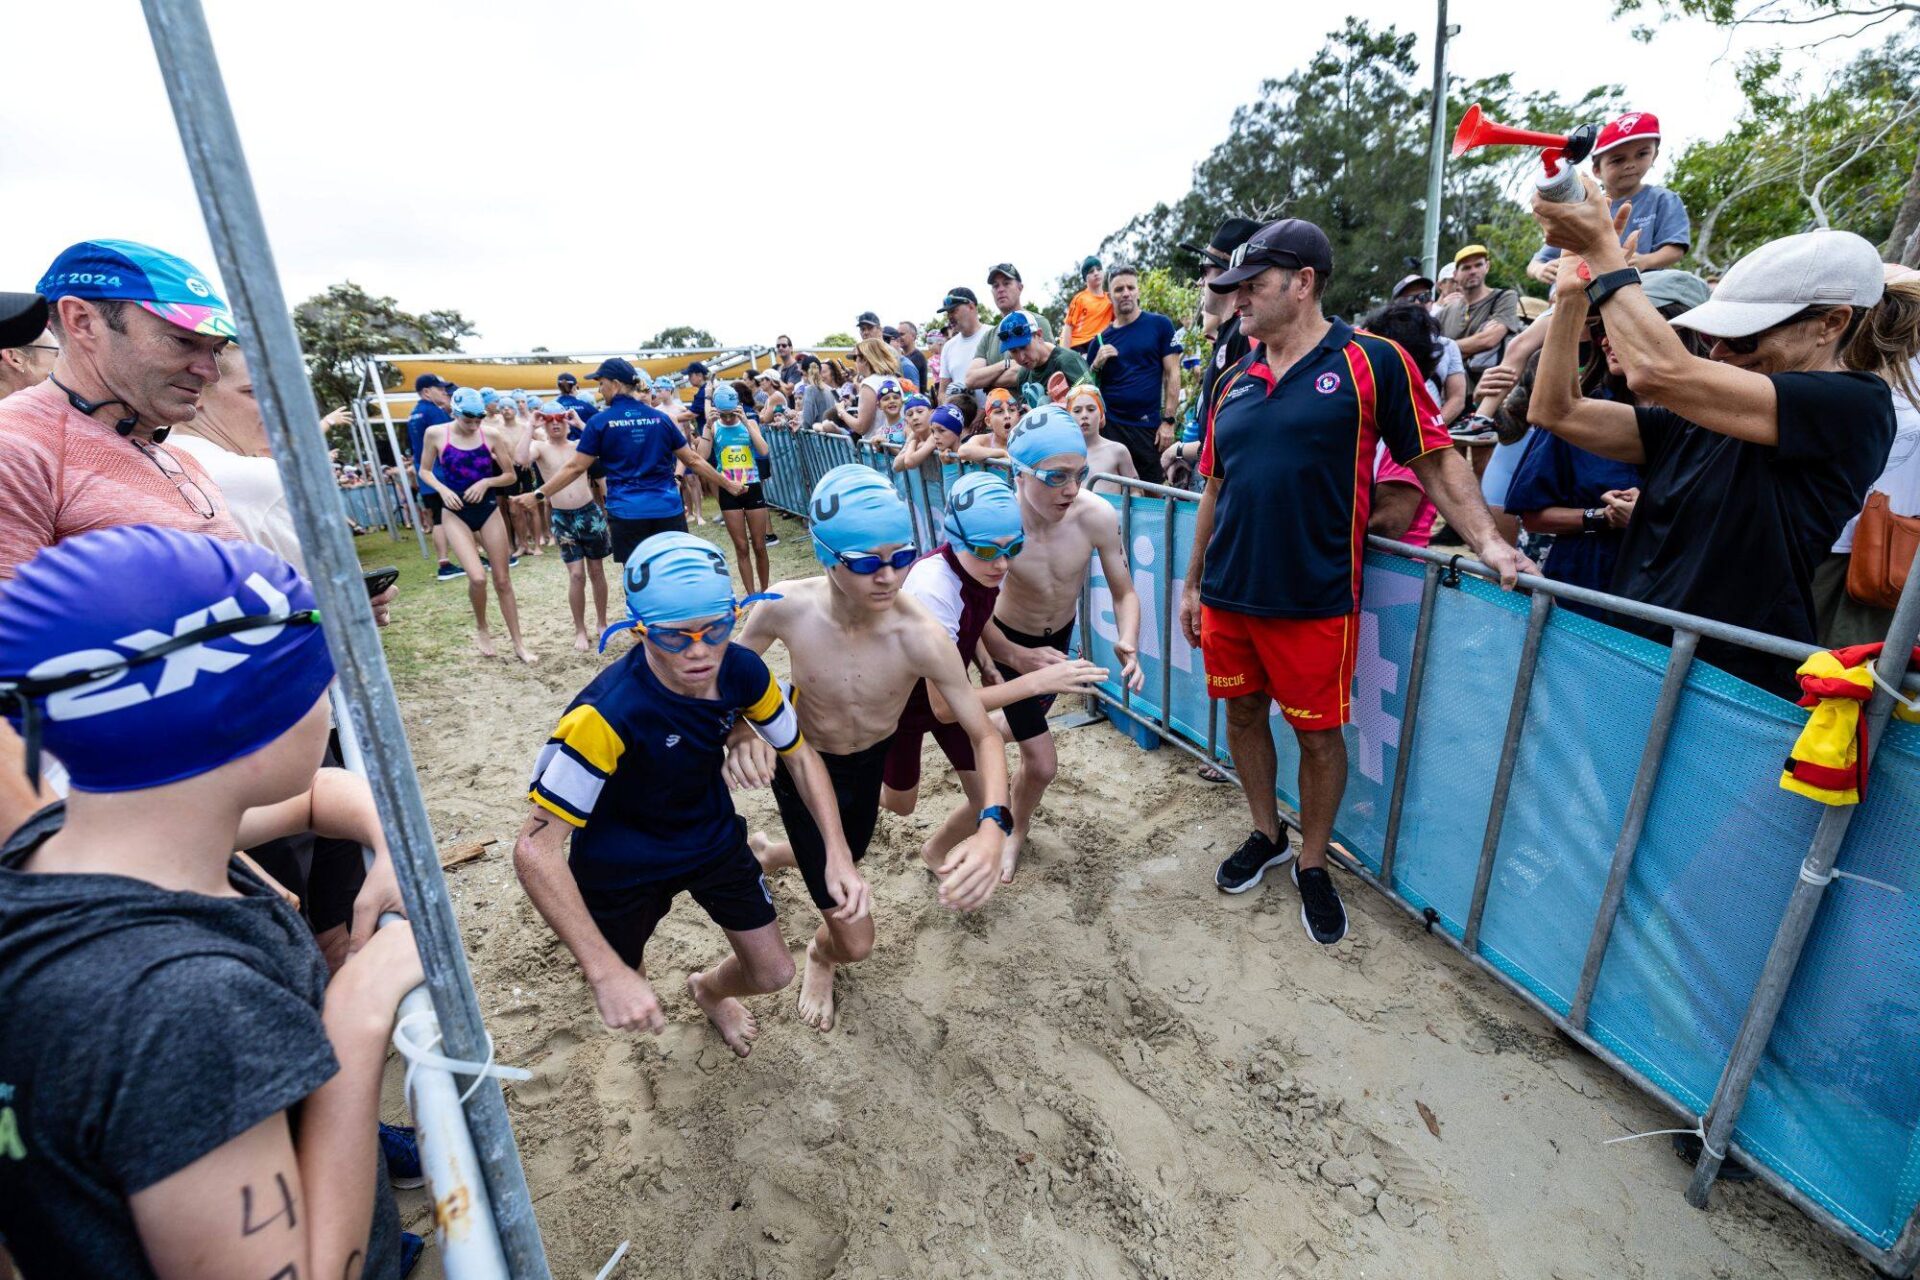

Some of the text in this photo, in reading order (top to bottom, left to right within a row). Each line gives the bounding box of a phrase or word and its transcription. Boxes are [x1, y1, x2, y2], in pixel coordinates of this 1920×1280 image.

[68, 272, 122, 288] 2024
[608, 417, 660, 428] EVENT STAFF
[727, 453, 748, 463] 560
[25, 571, 291, 722] 2XU
[1212, 673, 1246, 688] RESCUE
[241, 1171, 297, 1237] 4
